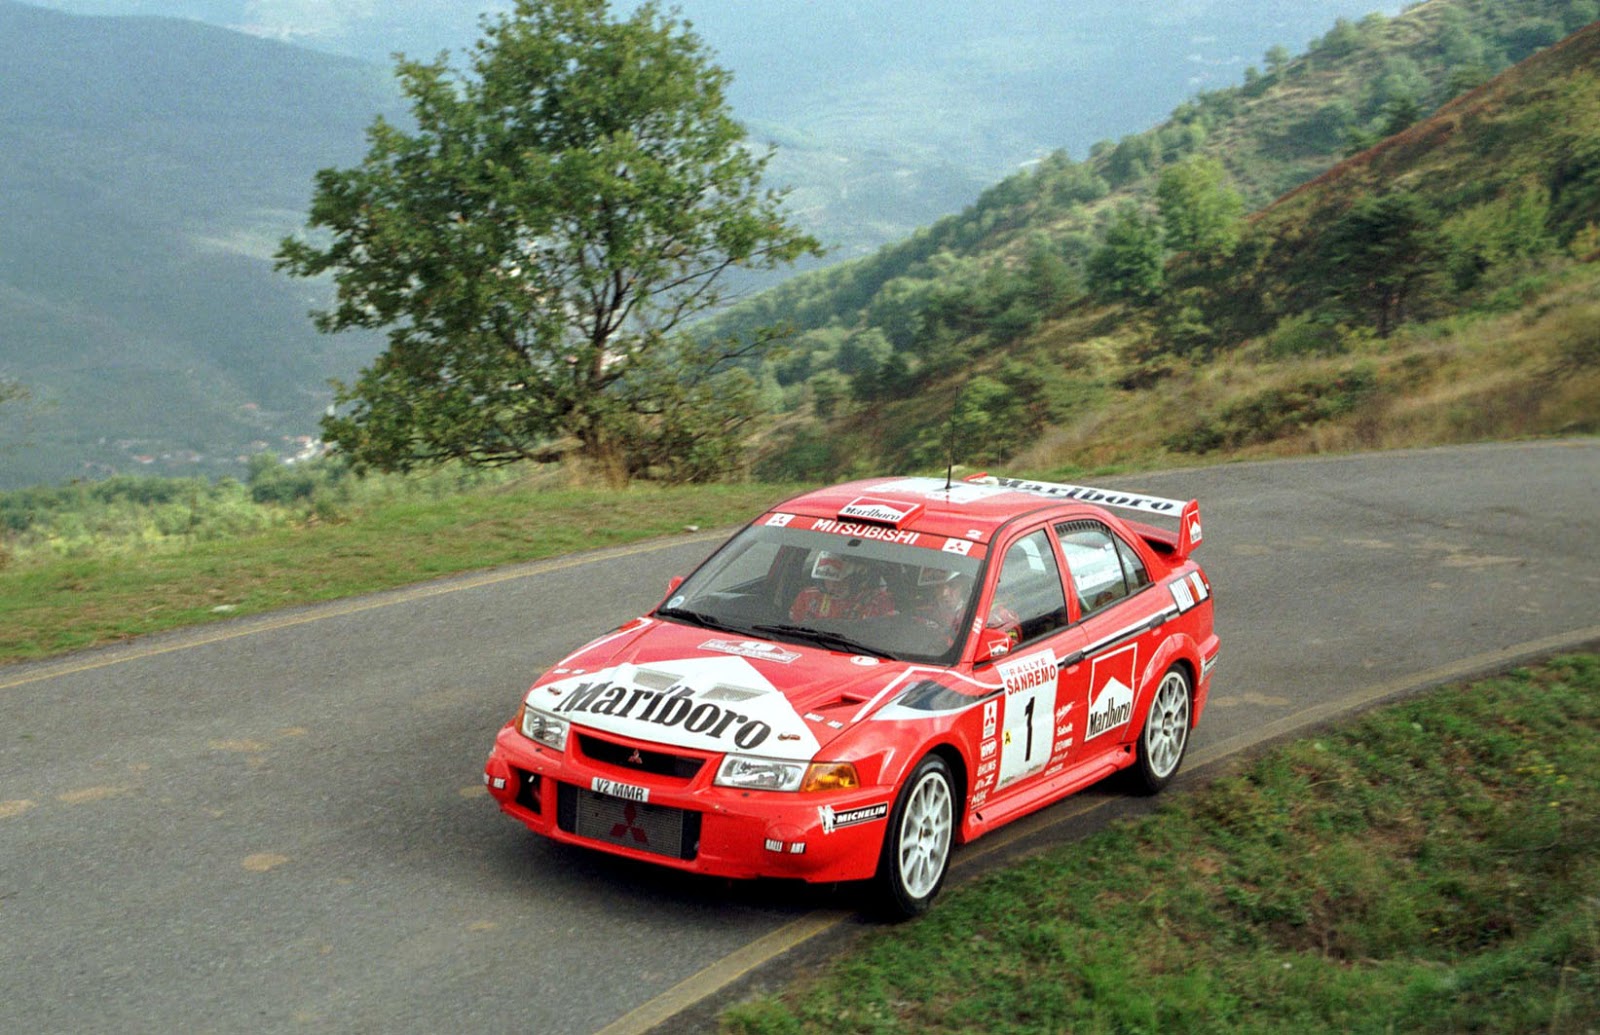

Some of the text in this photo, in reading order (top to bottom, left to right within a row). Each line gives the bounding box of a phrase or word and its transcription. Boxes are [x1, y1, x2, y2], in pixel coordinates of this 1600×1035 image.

[998, 477, 1174, 511] Marlboro
[844, 507, 900, 521] Marlboro
[811, 518, 920, 545] MITSUBISHI
[1006, 664, 1057, 696] SANREMO
[1009, 657, 1047, 676] RALLYE
[553, 680, 771, 749] Marlboro
[1088, 699, 1131, 738] Marlboro
[1005, 731, 1011, 744] A
[1024, 696, 1035, 762] 1
[596, 778, 644, 801] V2 MMR
[836, 805, 887, 823] MICHELIN
